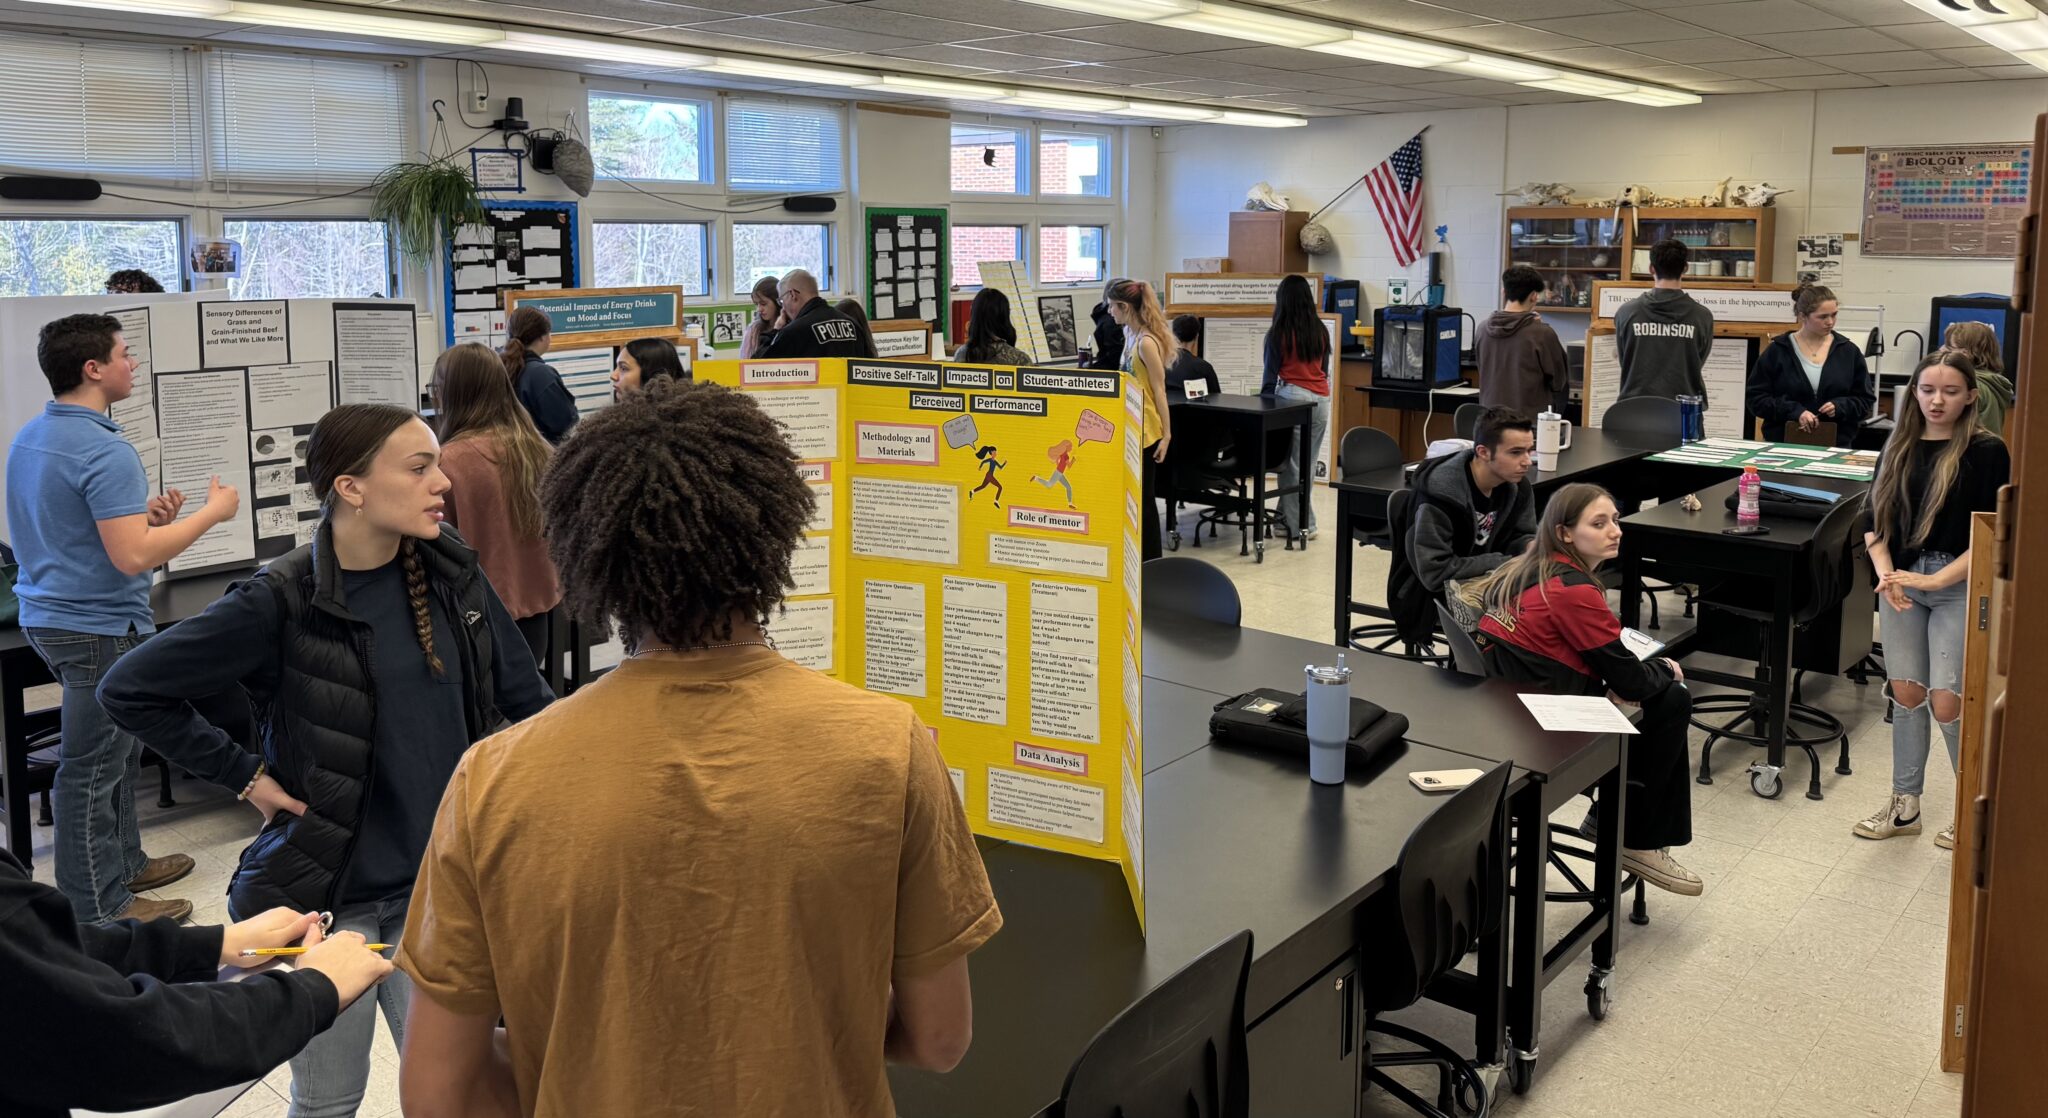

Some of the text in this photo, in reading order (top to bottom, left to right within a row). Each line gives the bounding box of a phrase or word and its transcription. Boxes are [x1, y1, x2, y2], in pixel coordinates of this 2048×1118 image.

[1906, 156, 1966, 166] BIOLOGY
[540, 299, 656, 312] Potential Impacts of Energy Drinks
[1742, 298, 1790, 308] hippocampus
[578, 313, 597, 322] Mood
[818, 322, 855, 340] POLICE
[1633, 323, 1694, 339] ROBINSON
[752, 368, 809, 378] Introduction
[854, 368, 1113, 389] Positive Self-Talk Impacts on Student-athletes'
[914, 396, 1041, 410] Perceived Performance
[862, 432, 930, 444] Methodology and
[878, 446, 916, 457] Materials
[1017, 512, 1081, 527] Role of mentor
[1021, 748, 1080, 768] Data Analysis
